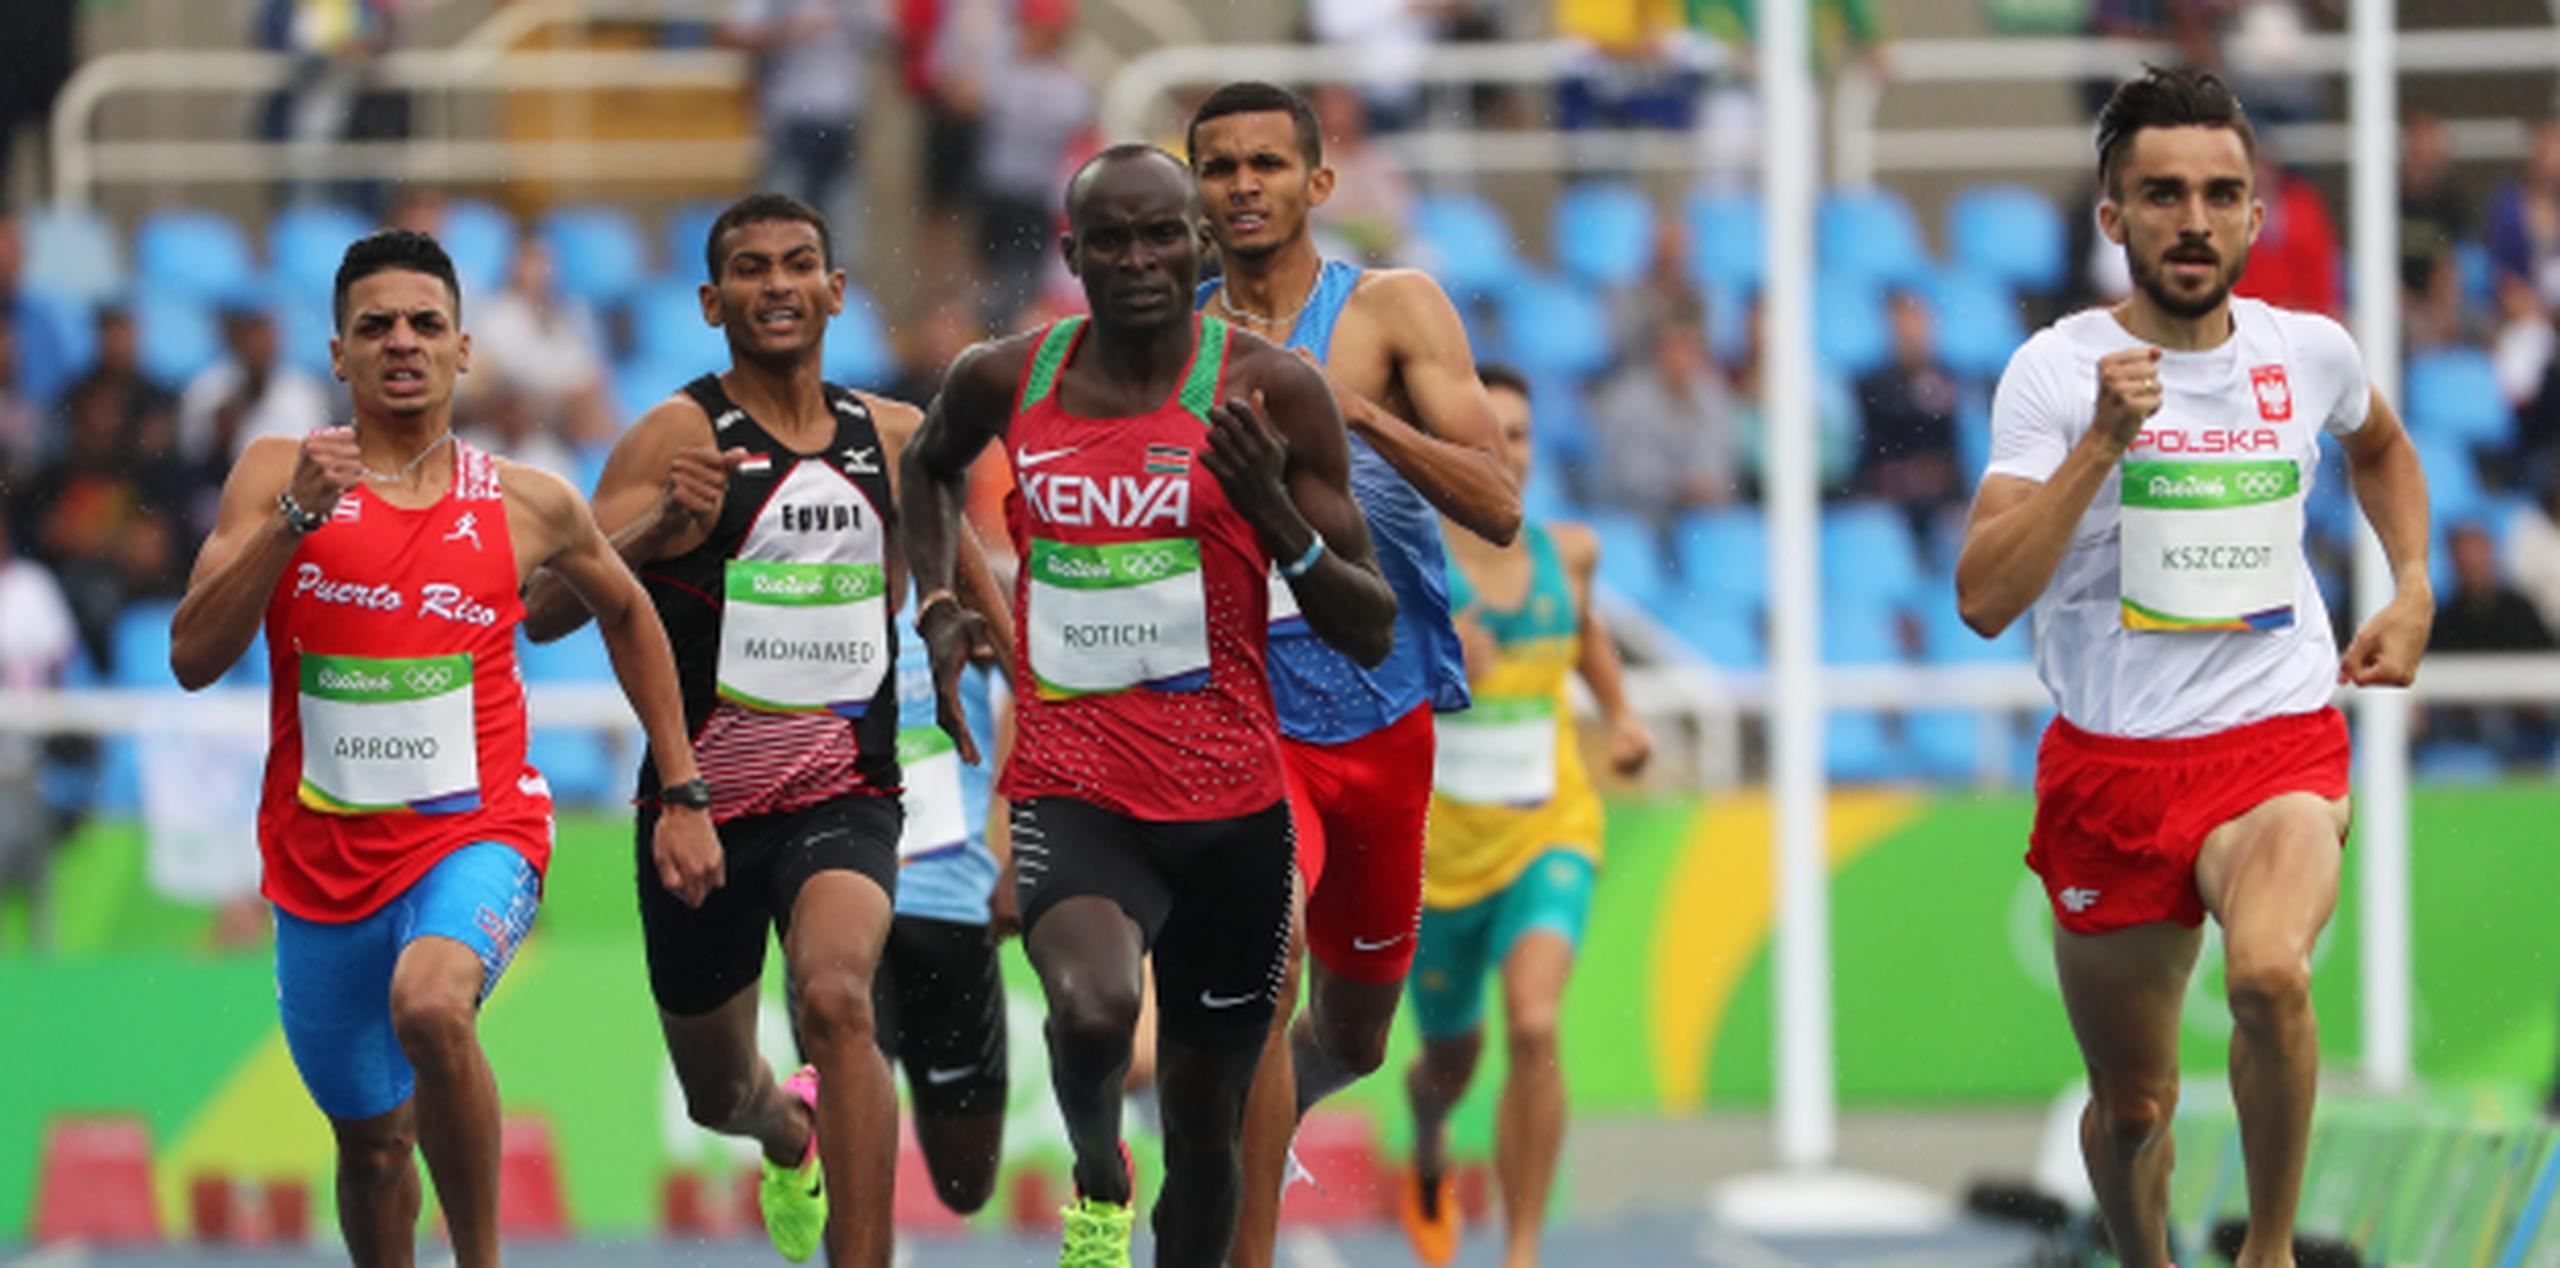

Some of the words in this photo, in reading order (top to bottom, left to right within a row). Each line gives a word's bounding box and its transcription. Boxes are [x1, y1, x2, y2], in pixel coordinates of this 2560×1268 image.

[2129, 429, 2278, 452] POLSKA
[1019, 473, 1189, 526] KENYA
[783, 505, 861, 531] Egypt
[2163, 547, 2271, 569] KSZCZOT
[294, 563, 402, 610] Puerto
[419, 584, 496, 626] Rico
[1063, 623, 1159, 648] ROTICH
[744, 638, 876, 665] MOHAMED
[335, 737, 438, 759] ARROYO
